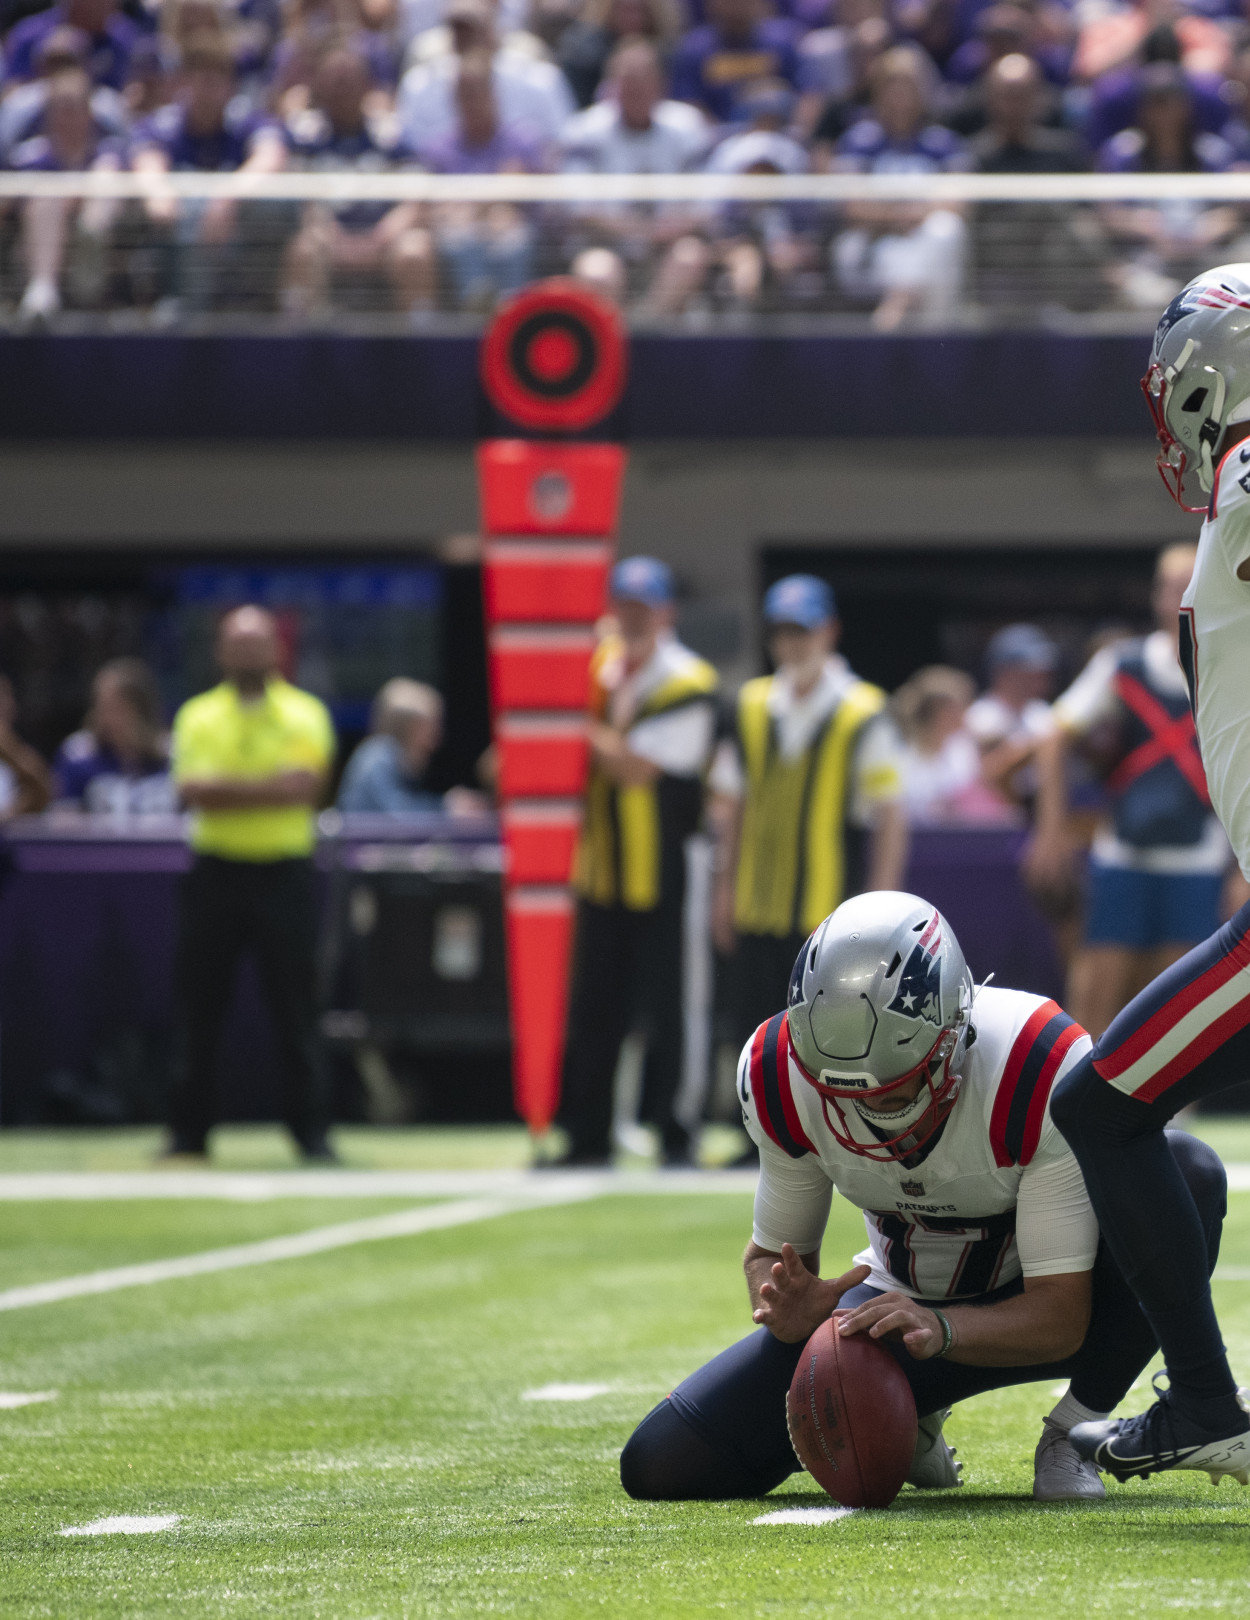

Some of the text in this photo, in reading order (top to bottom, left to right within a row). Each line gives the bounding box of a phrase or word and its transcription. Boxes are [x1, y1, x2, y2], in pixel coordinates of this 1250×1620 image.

[896, 1201, 957, 1214] PATRIOTS
[872, 1207, 1016, 1298] 17
[809, 1355, 817, 1385] LEAGUE
[809, 1387, 821, 1431] FOOTBALL
[818, 1432, 840, 1472] NATIONAL
